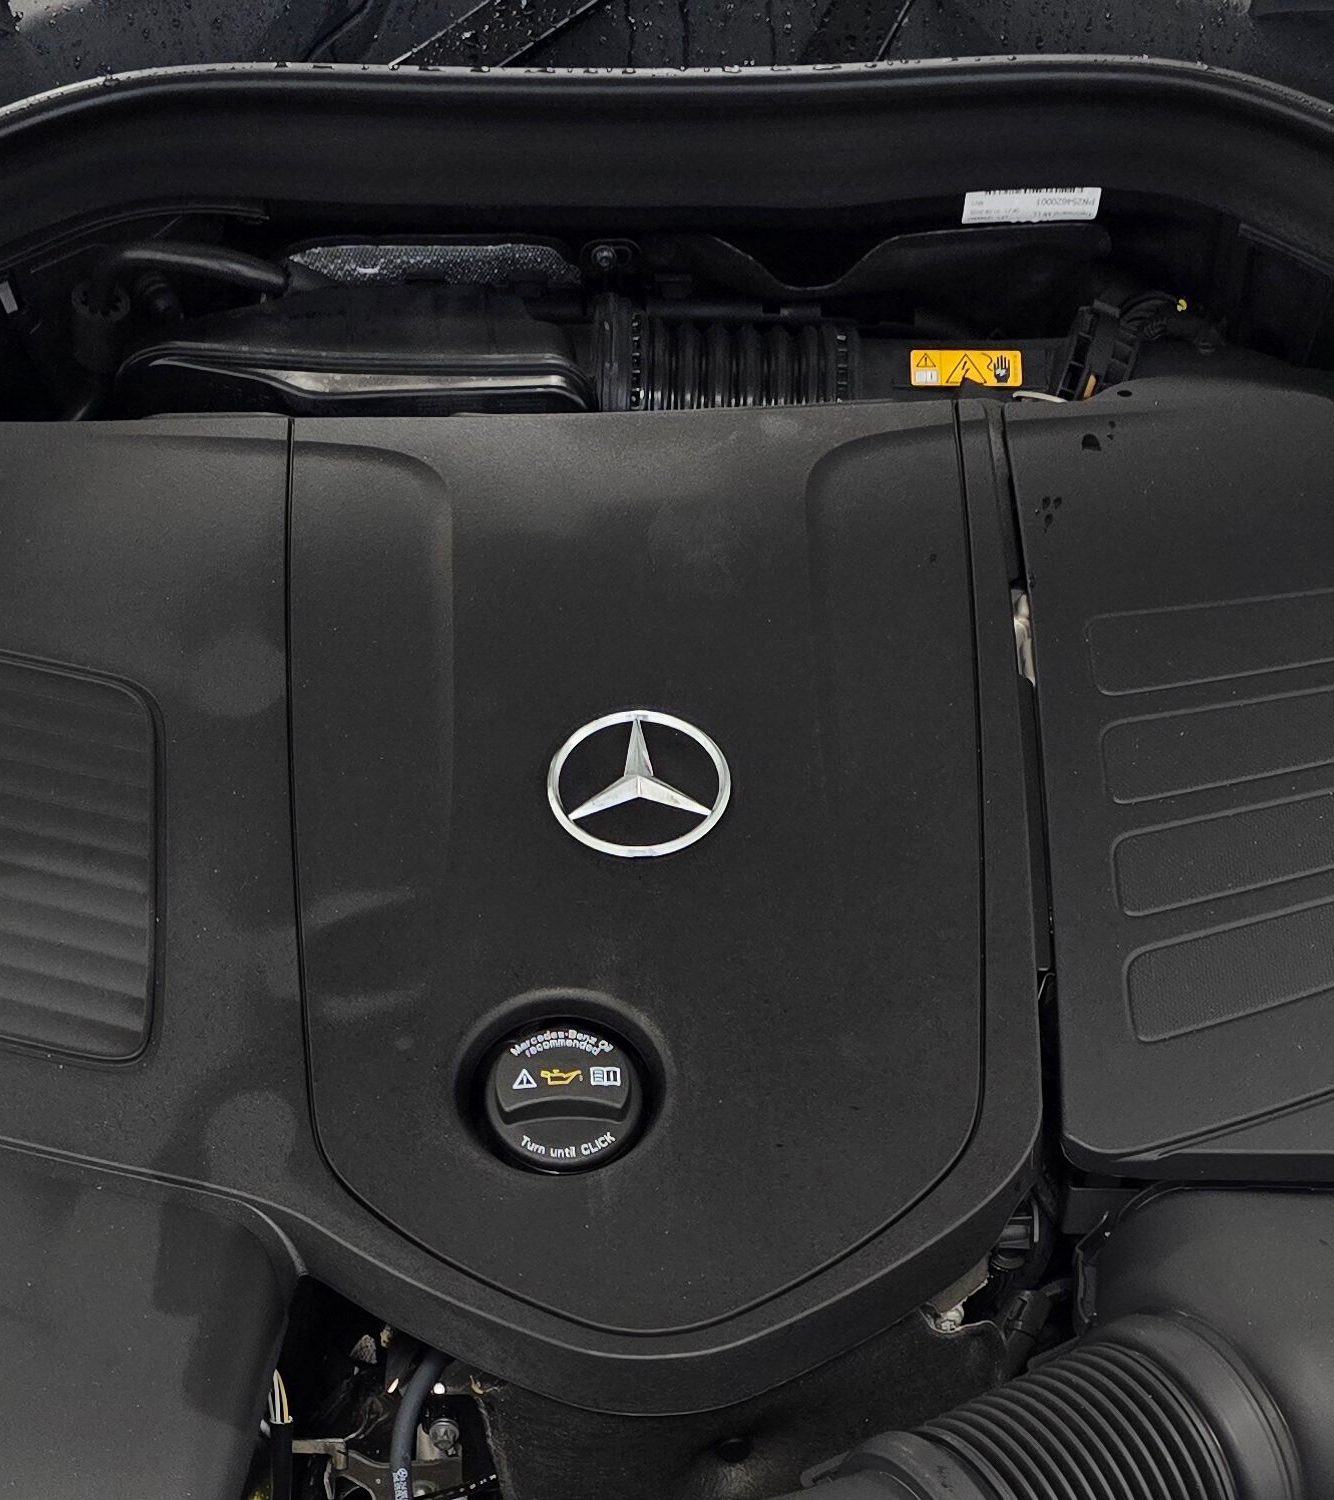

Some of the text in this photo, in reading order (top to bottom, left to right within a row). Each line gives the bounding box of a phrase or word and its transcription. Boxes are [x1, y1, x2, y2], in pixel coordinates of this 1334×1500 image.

[509, 1028, 615, 1057] Mercedes-Benz Oil
[524, 1038, 601, 1058] recommended
[521, 1131, 617, 1158] Turn until CLICK
